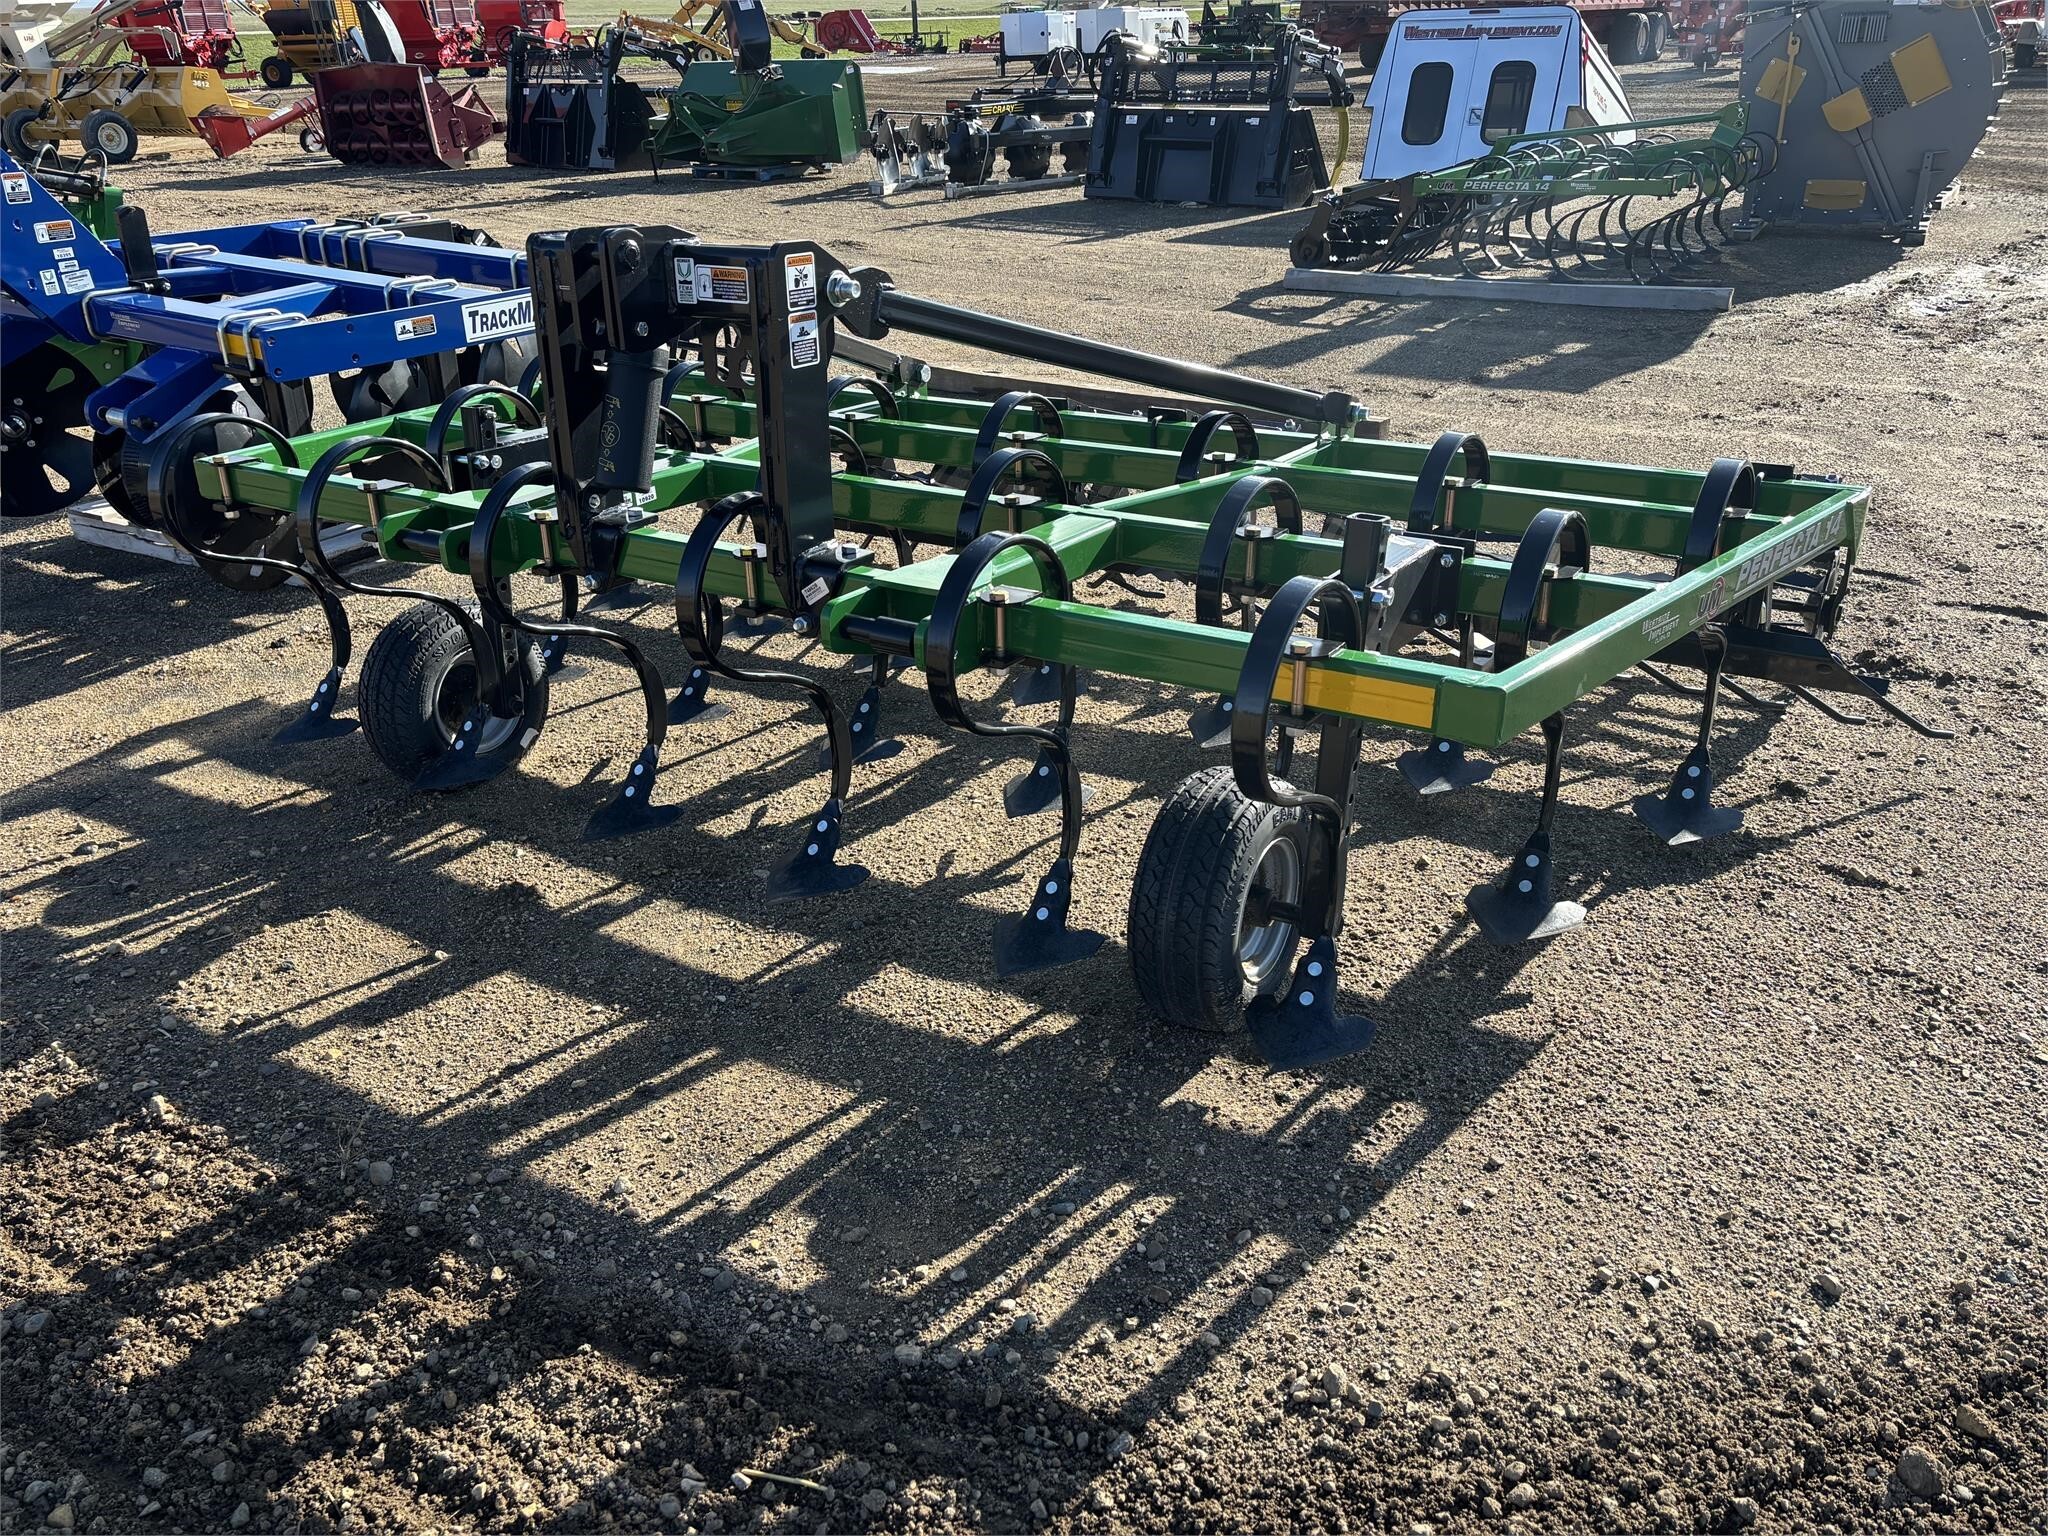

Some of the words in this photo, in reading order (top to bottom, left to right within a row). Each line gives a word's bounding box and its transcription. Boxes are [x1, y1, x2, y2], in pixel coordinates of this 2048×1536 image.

[992, 104, 1015, 114] CRARY
[1463, 181, 1530, 190] PERFECTA
[1535, 182, 1550, 191] 14
[719, 269, 745, 280] WARNING
[468, 301, 534, 334] TRACKM
[1735, 521, 1822, 592] PERFECTA
[1824, 510, 1845, 541] 14
